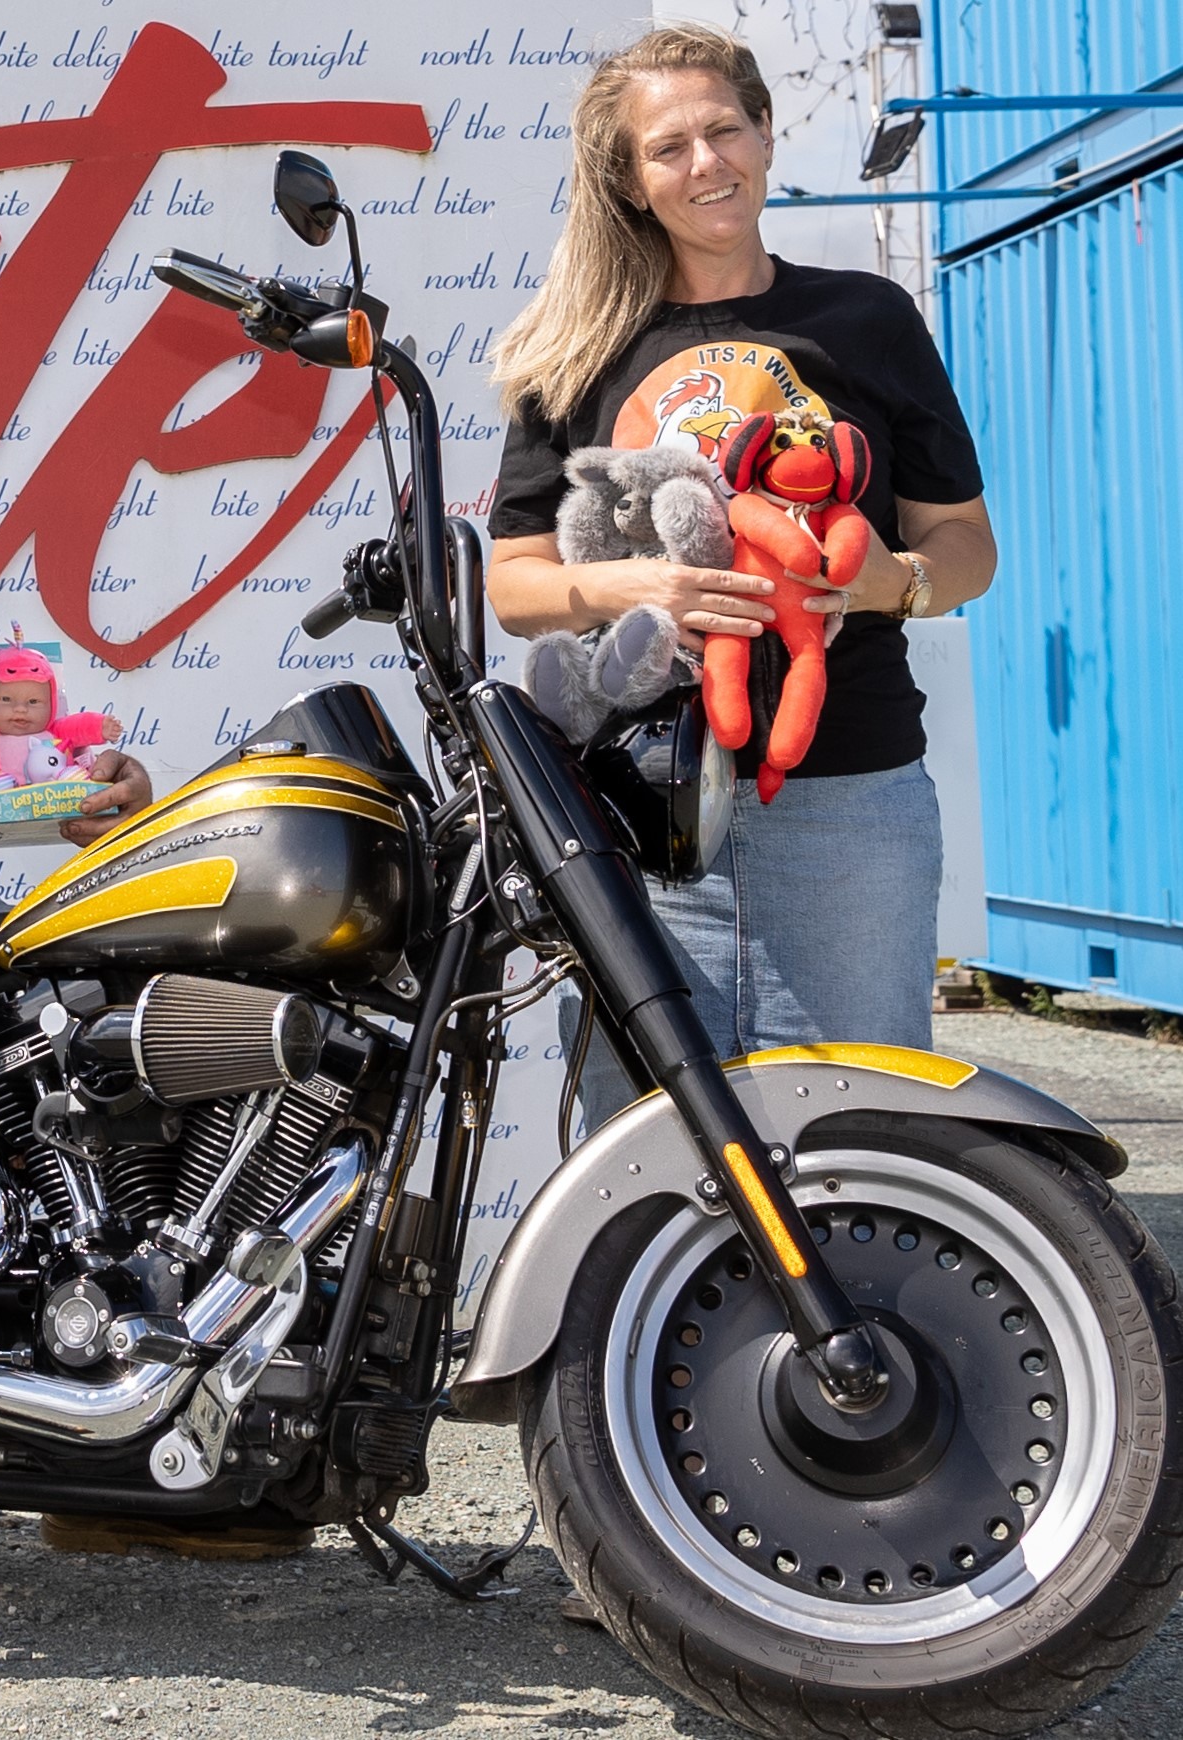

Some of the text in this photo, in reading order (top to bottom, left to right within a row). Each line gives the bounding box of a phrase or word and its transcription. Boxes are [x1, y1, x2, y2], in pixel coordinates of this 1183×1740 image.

[208, 29, 368, 79] bite tonight
[420, 28, 494, 65] north
[464, 103, 505, 140] the
[167, 179, 214, 216] bite
[362, 177, 495, 215] and biter
[425, 252, 498, 290] north
[73, 328, 121, 366] bite
[427, 322, 465, 378] of
[698, 347, 809, 409] ITS A WING
[439, 403, 500, 441] biter
[211, 479, 259, 517] bite
[90, 567, 136, 592] iter
[242, 578, 310, 592] more
[171, 632, 220, 669] bite
[278, 626, 355, 670] lovers
[215, 707, 253, 746] bit
[1104, 1303, 1163, 1553] AMERICAN
